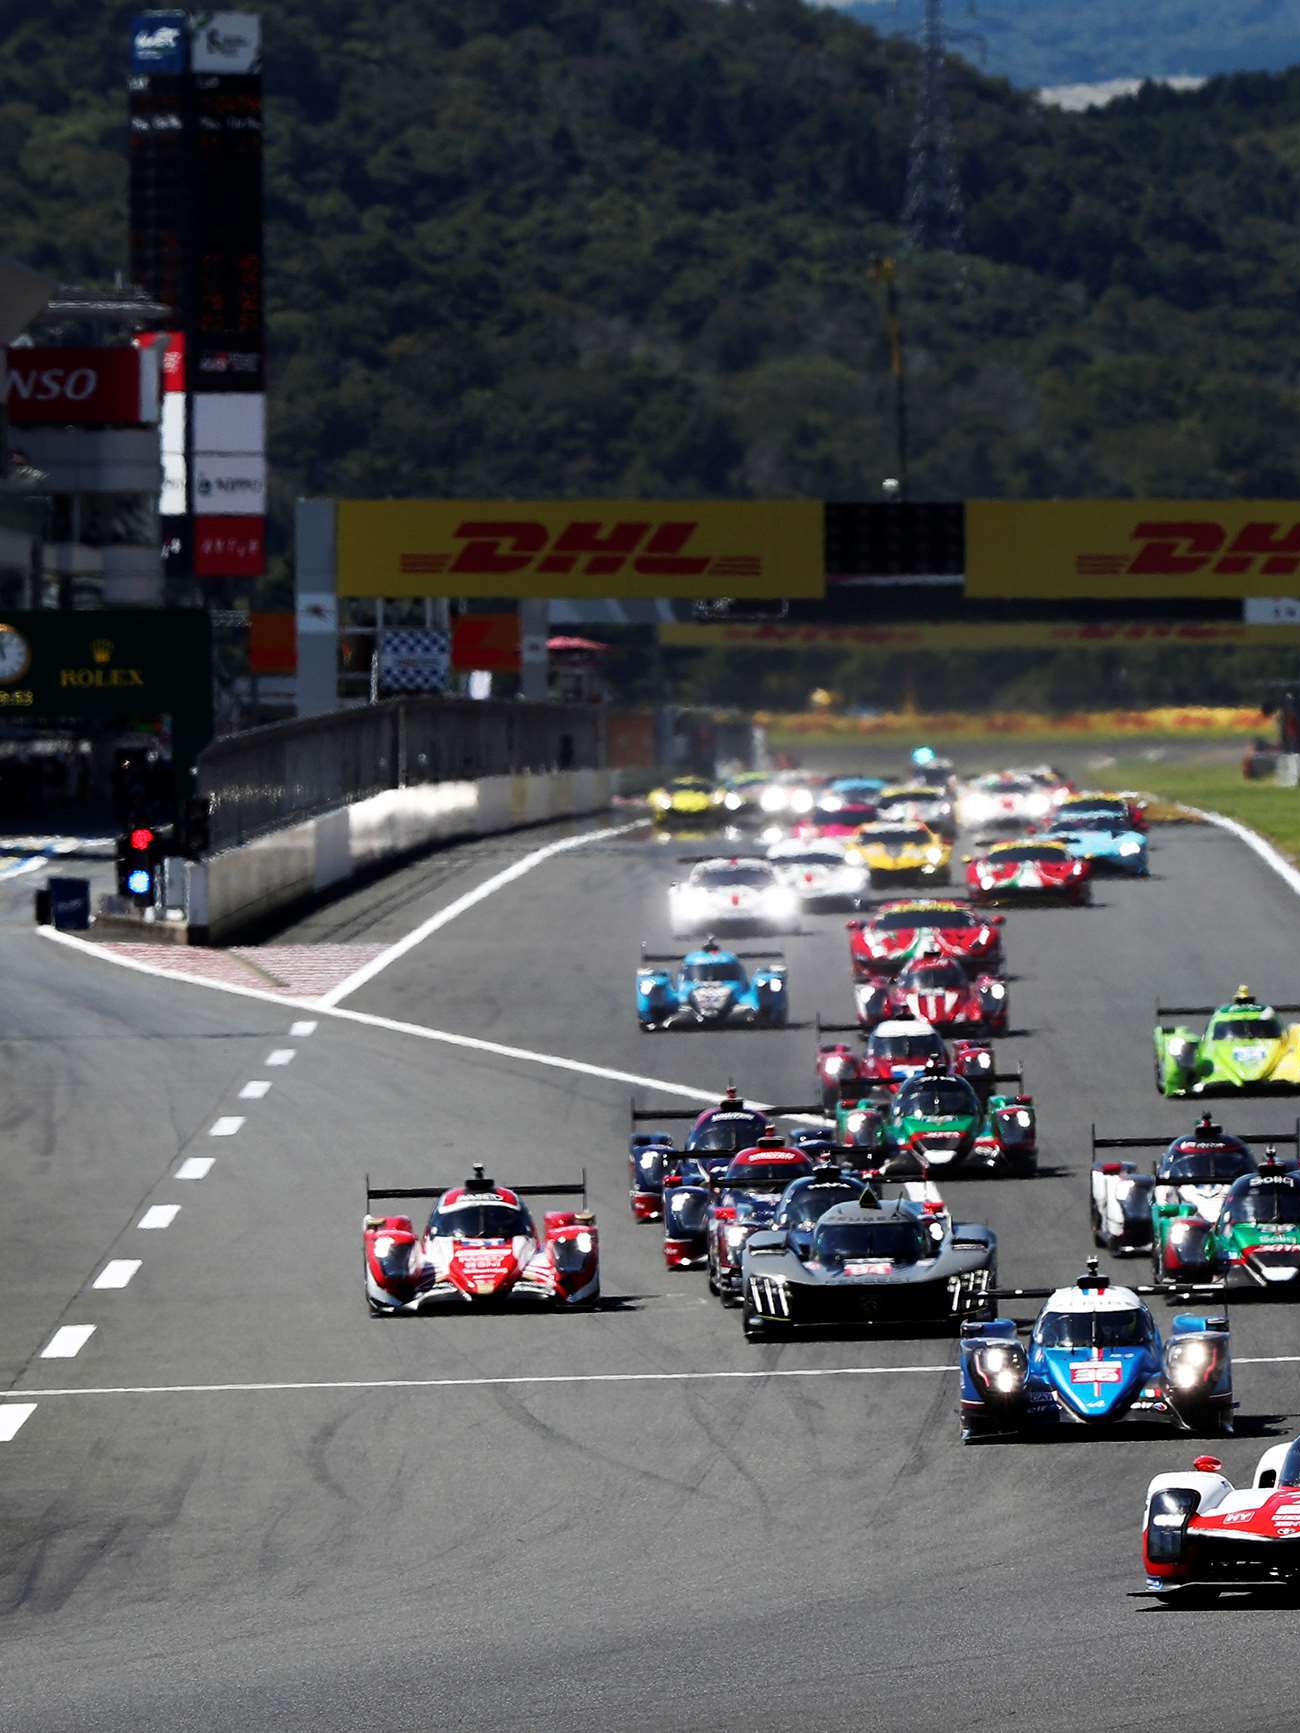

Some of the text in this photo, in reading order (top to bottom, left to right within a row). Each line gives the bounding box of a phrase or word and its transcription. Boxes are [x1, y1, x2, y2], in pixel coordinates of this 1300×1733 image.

[7, 368, 97, 401] NSO
[448, 521, 711, 576] DHL
[60, 669, 145, 688] ROLEX
